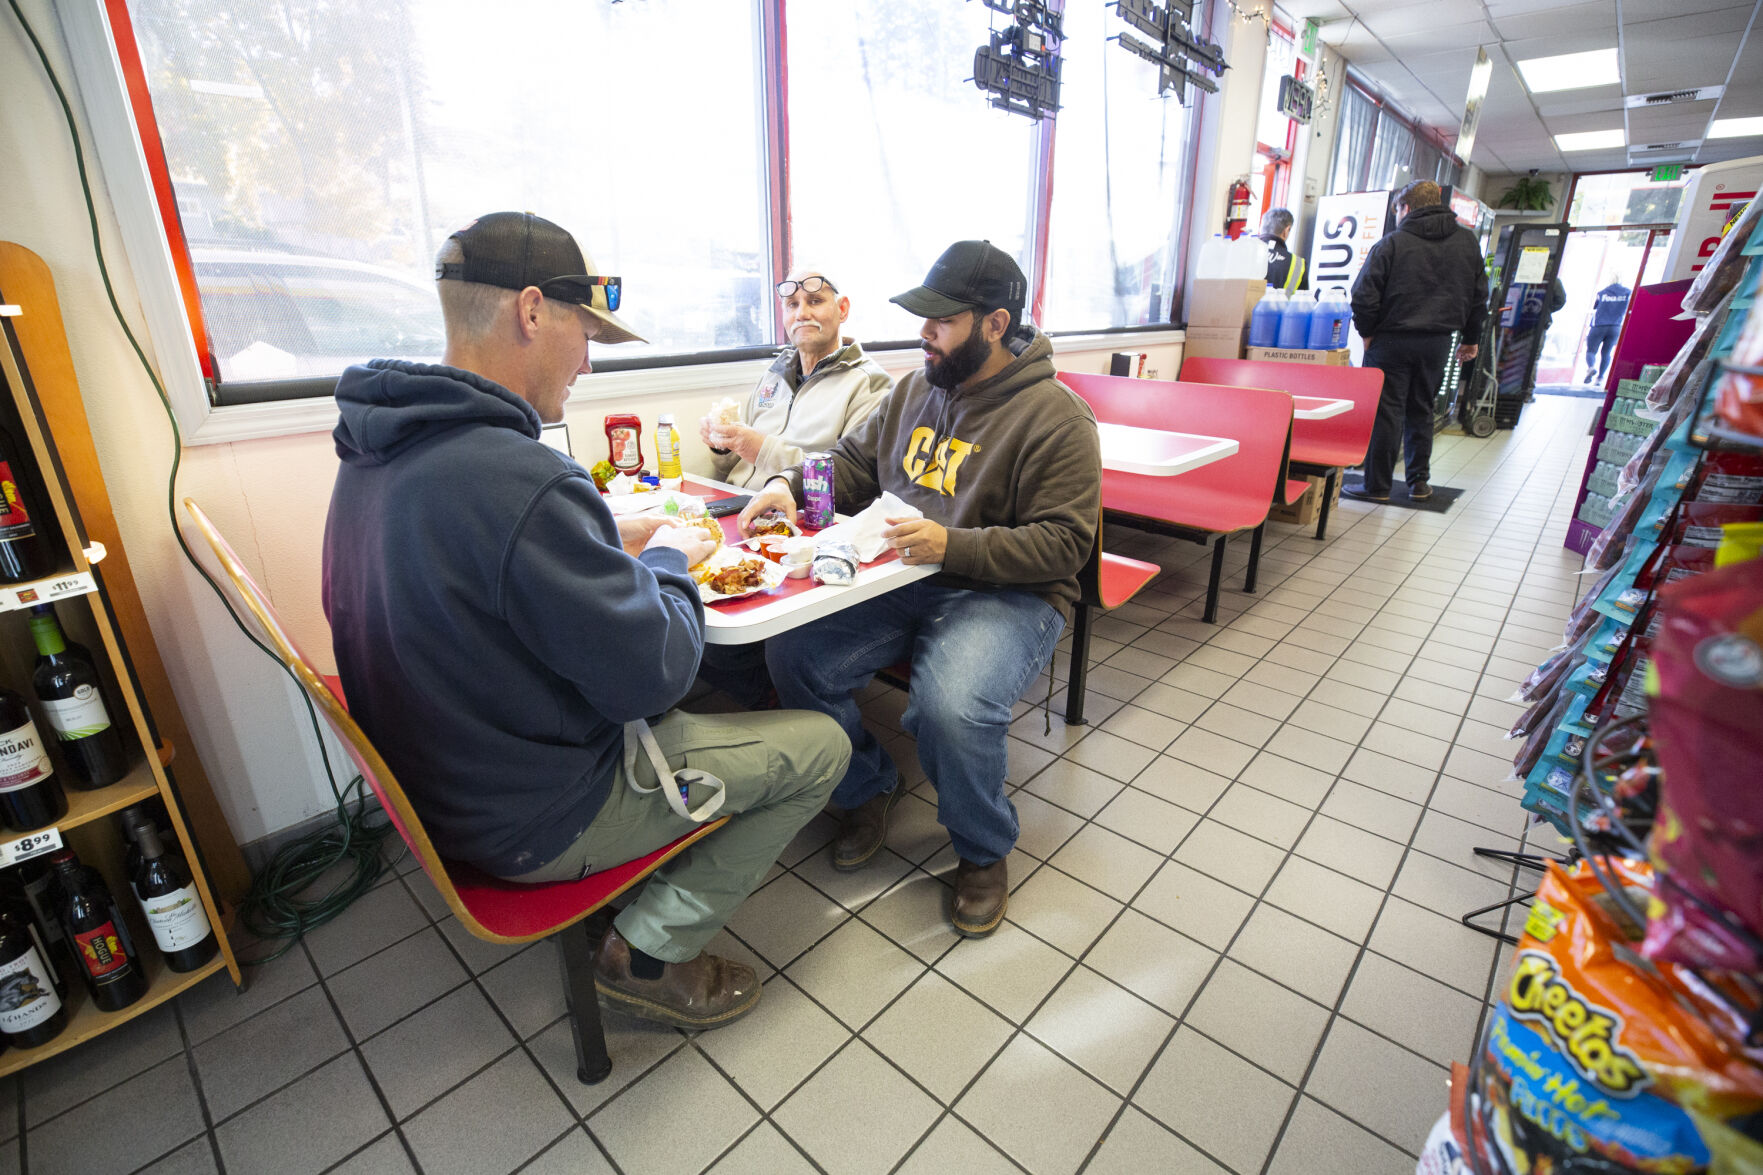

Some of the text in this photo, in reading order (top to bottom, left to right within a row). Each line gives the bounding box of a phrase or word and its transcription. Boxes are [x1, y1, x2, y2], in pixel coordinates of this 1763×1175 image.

[1656, 166, 1680, 180] EXIT
[1362, 215, 1377, 240] FIT
[1263, 351, 1316, 361] PLASTIC BOTTLES
[803, 475, 830, 492] ush
[92, 937, 112, 966] HOGUE
